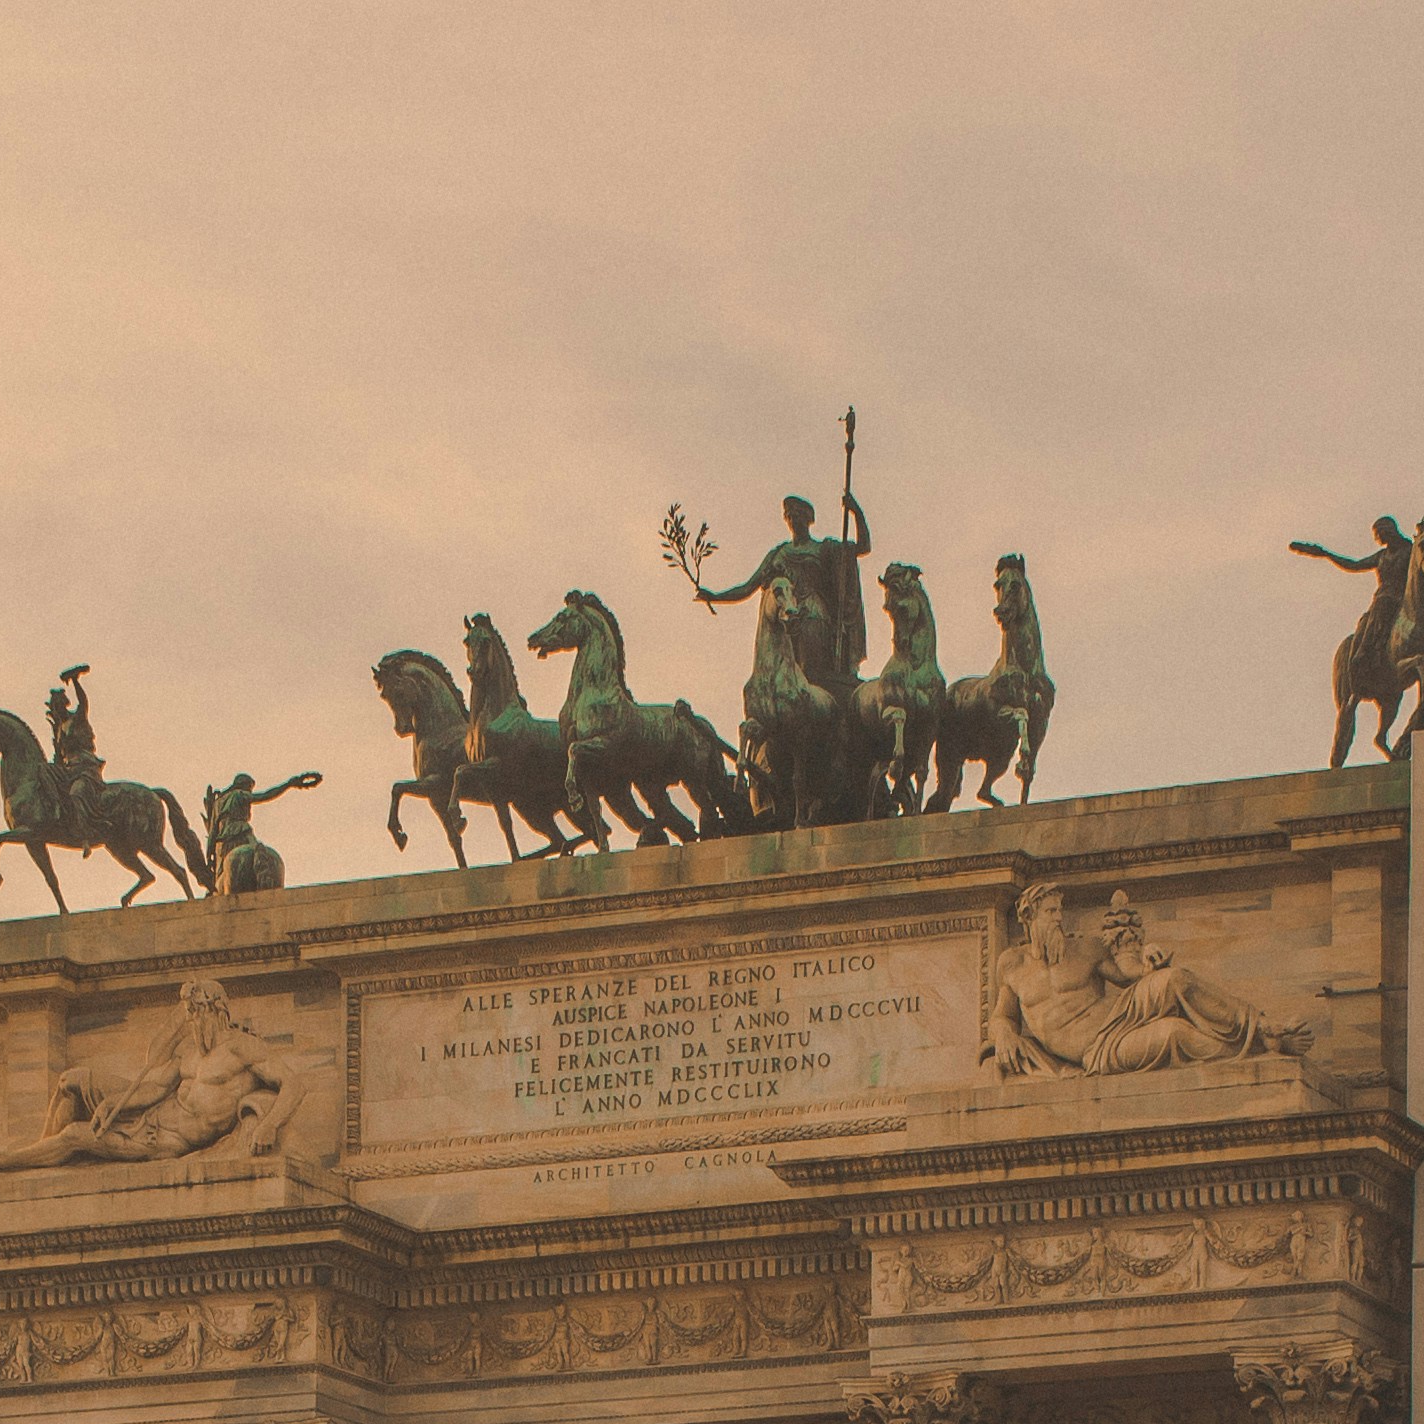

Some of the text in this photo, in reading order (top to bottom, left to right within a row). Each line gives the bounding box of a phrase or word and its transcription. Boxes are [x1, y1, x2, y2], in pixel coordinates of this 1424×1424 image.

[463, 955, 875, 1012] ALLE SPERANZE DEL REGNO ITALICO
[552, 987, 782, 1026] AUSPICE NAPOLEONE I
[420, 1046, 426, 1062] I
[443, 1035, 541, 1060] MILANESI
[559, 1020, 695, 1049] DEDICARONO
[734, 1010, 790, 1031] ANNO
[809, 996, 921, 1023] MDCCCVII
[531, 1030, 811, 1074] E FRANCATI DA SERVITU
[514, 1052, 831, 1098] FELICEMENTE RESTITUIRONO
[582, 1093, 642, 1114] ANNO
[658, 1080, 779, 1107] MDCCCLIX
[533, 1150, 777, 1184] ARCHITETTO CAGNOLA
